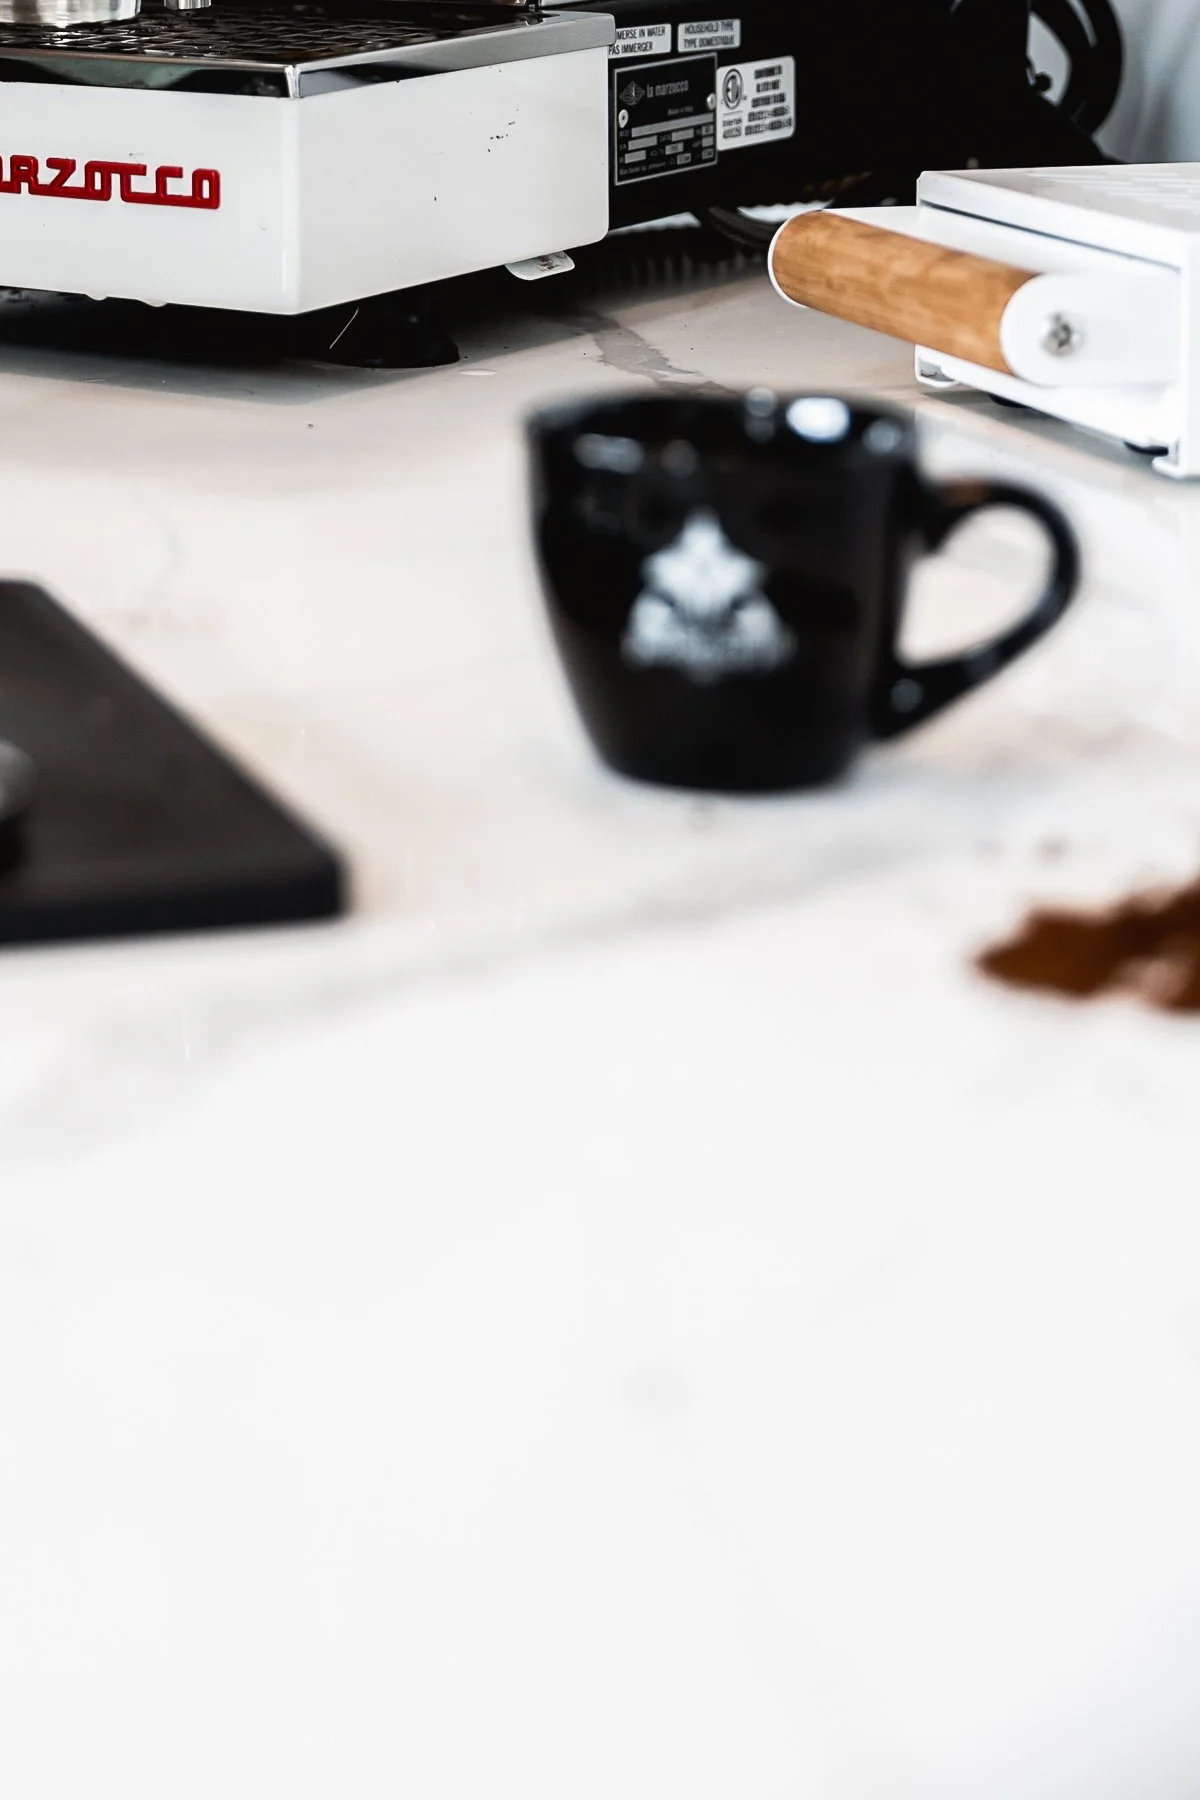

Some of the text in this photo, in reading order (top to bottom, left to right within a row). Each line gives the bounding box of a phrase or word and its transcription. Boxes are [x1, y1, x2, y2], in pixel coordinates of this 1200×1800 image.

[616, 26, 666, 40] MERSE IN WATER
[621, 41, 653, 54] IMMERGER
